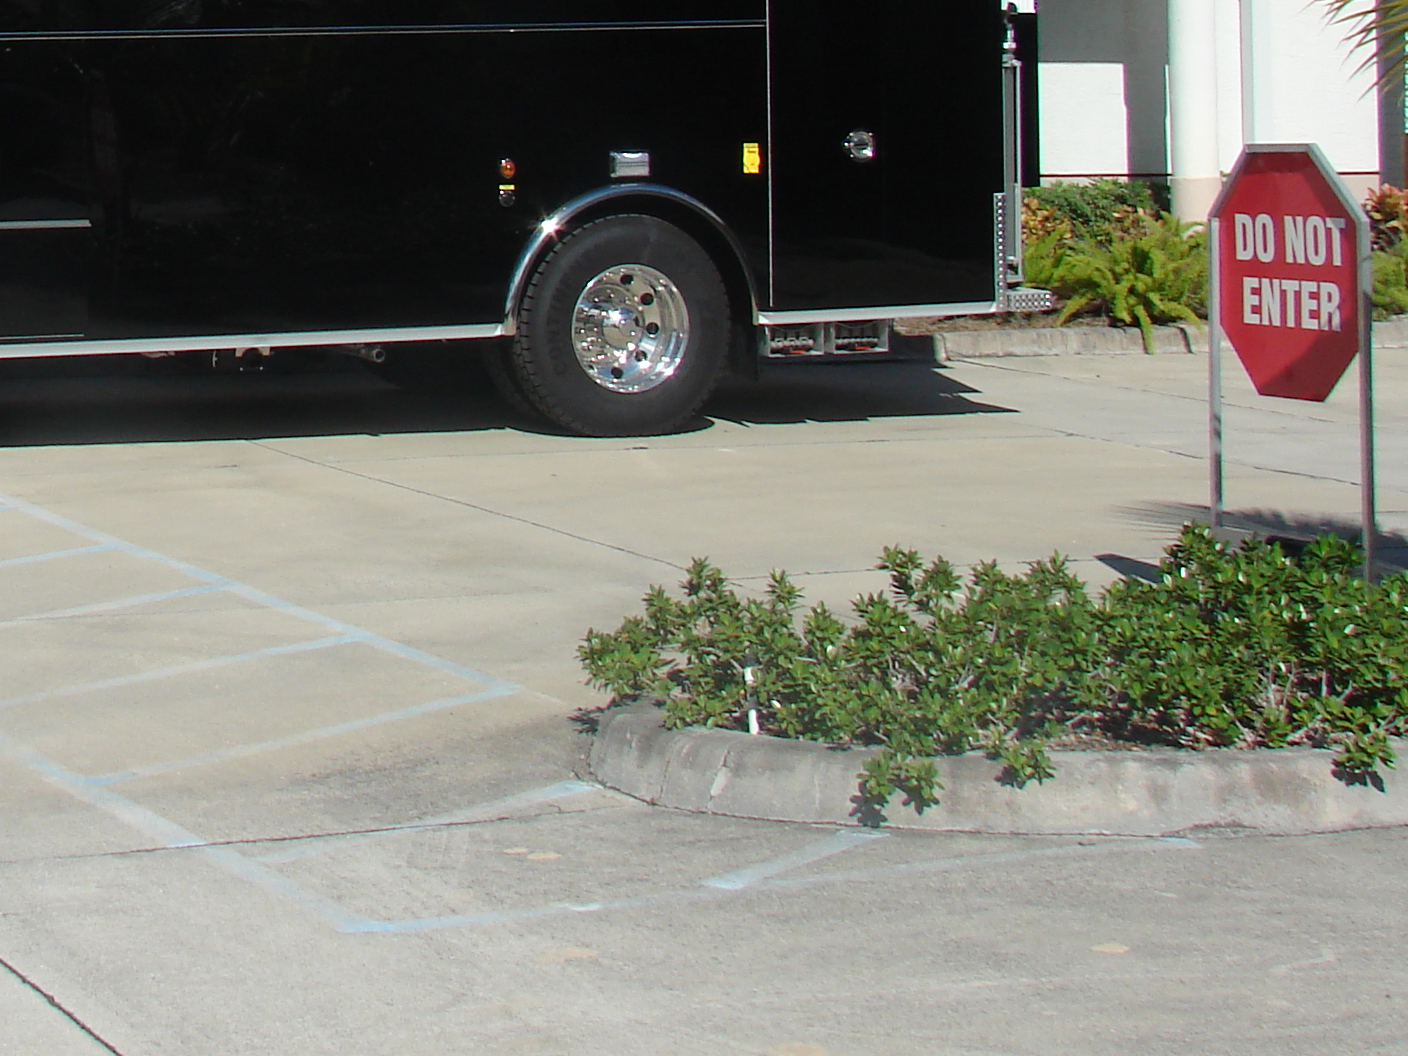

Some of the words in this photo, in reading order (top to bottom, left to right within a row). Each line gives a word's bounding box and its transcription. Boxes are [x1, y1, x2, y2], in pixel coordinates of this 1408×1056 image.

[1234, 213, 1276, 263] DO
[1284, 215, 1346, 266] NOT
[1242, 276, 1342, 332] ENTER
